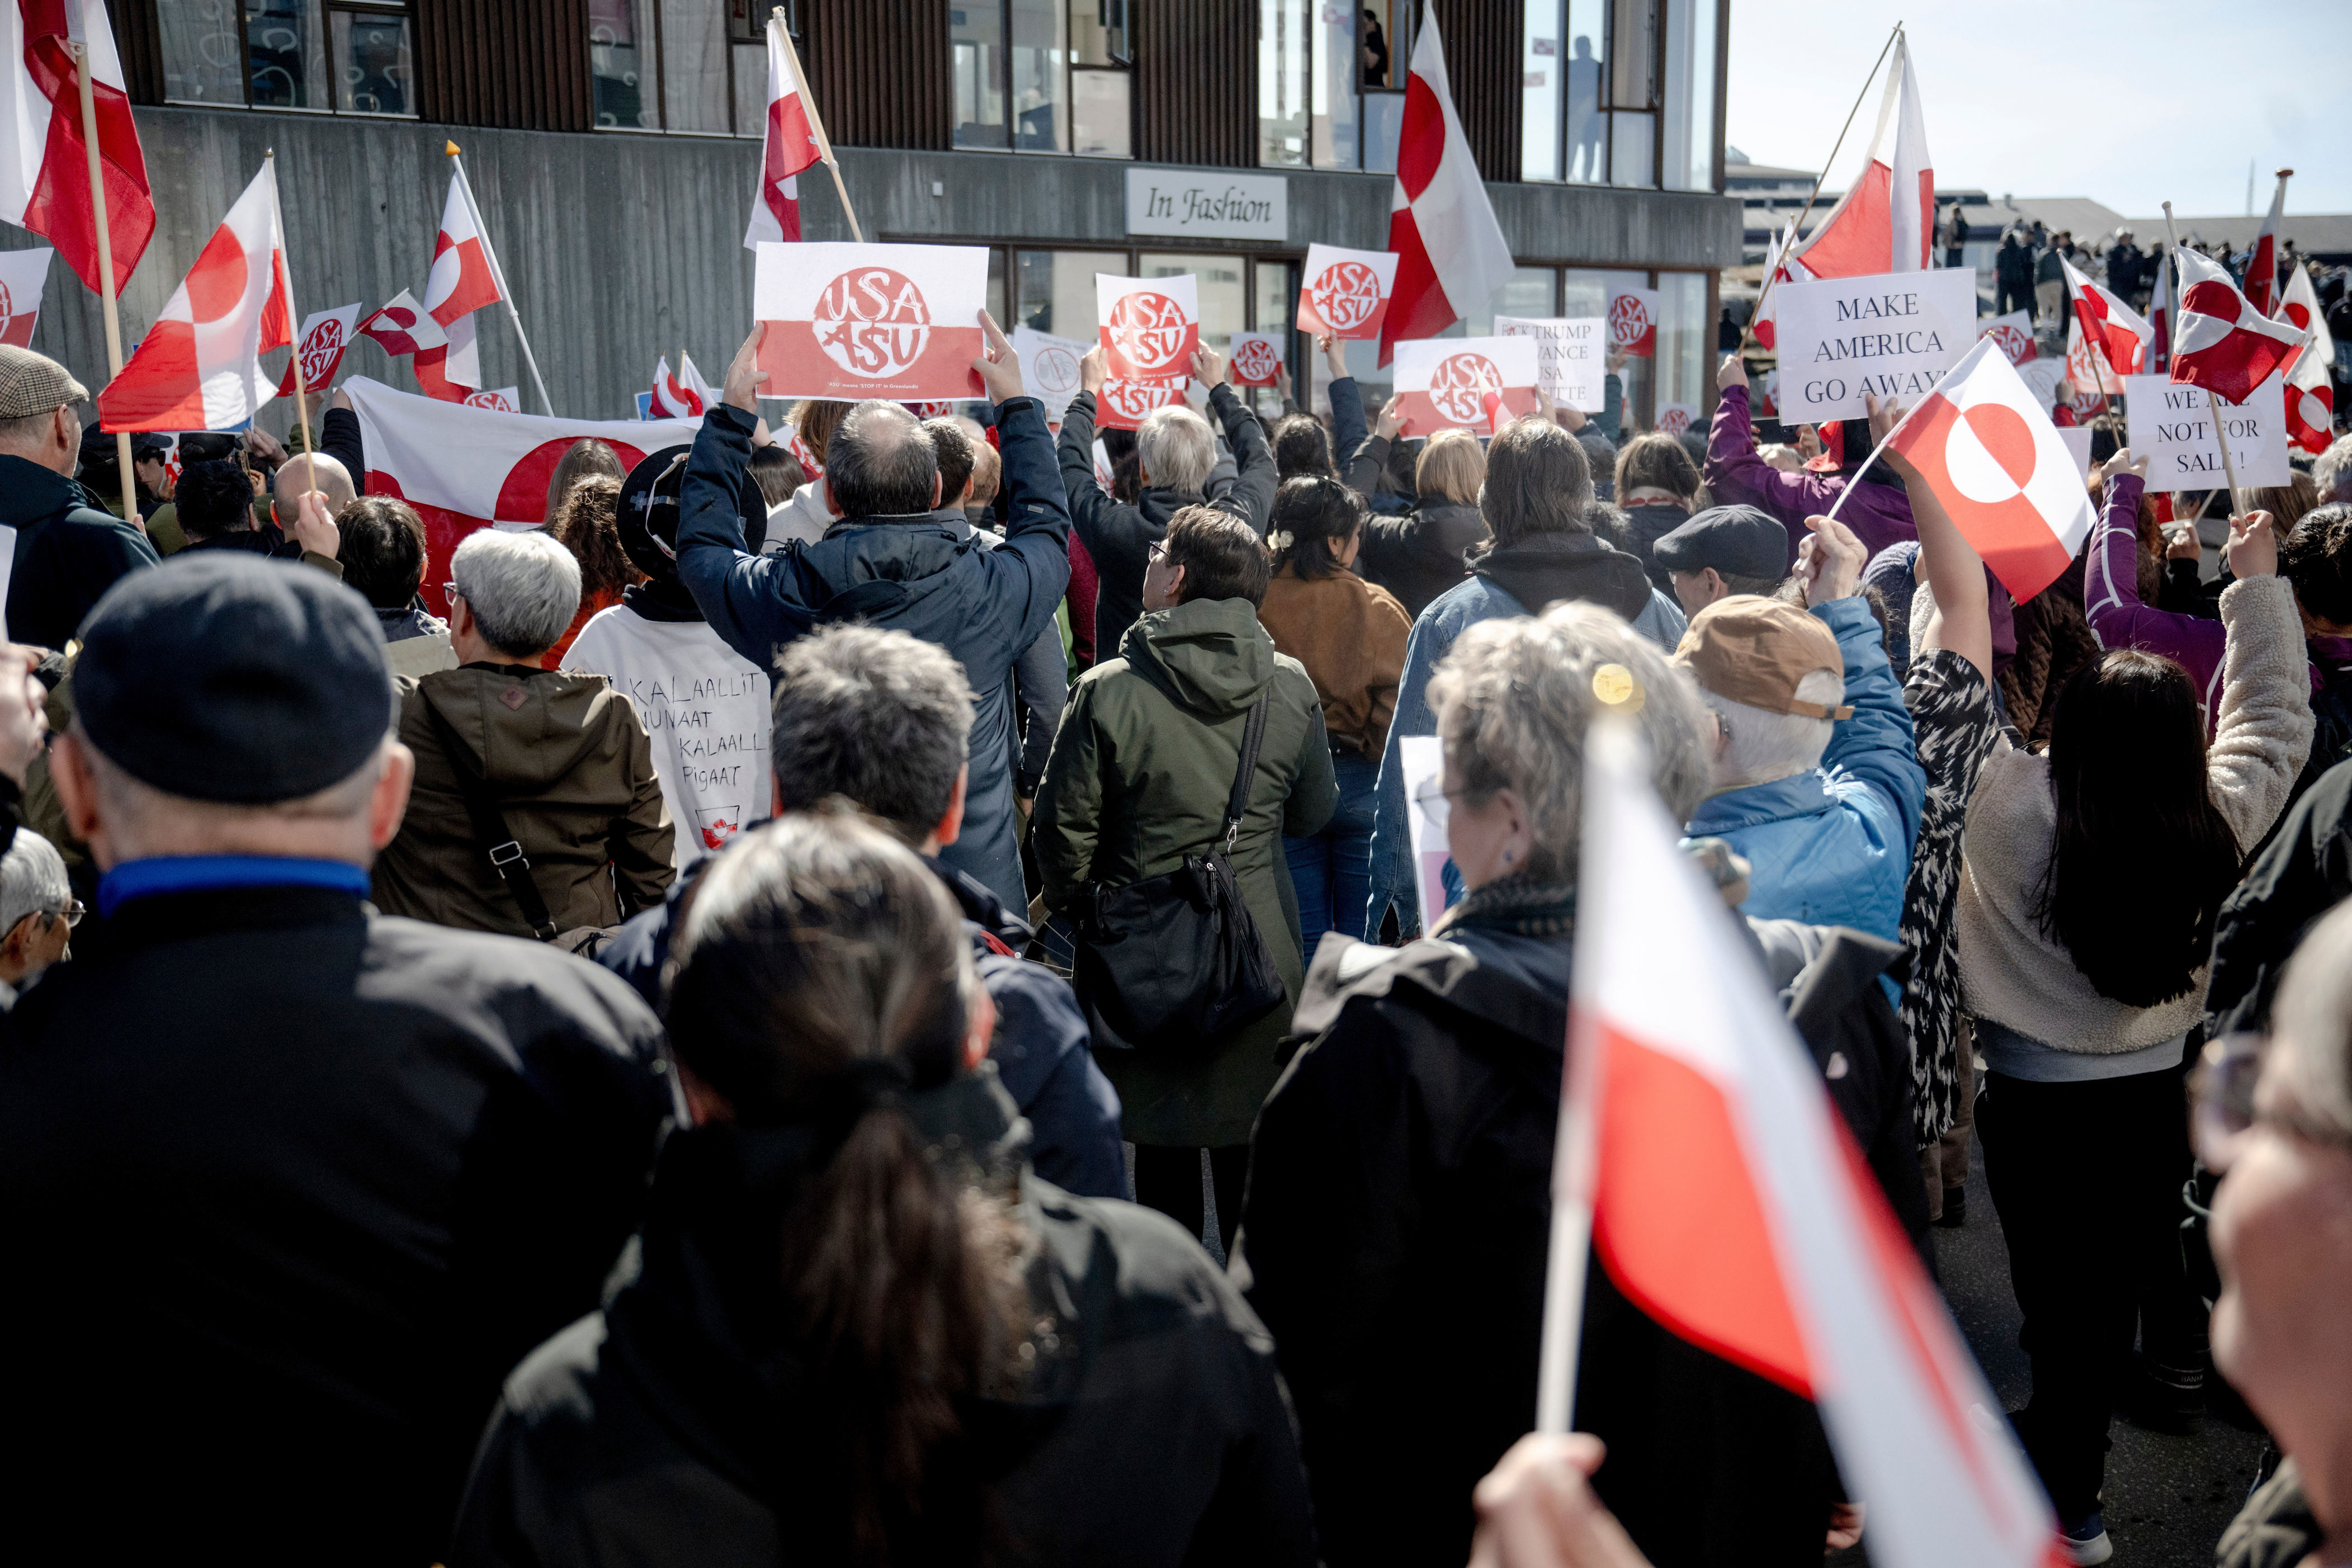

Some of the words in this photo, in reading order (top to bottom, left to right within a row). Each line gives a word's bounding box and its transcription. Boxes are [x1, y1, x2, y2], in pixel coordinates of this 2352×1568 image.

[1145, 187, 1173, 218] In
[1180, 185, 1273, 225] Fashion
[1321, 264, 1377, 297] USA
[824, 271, 925, 324] USA
[1114, 295, 1183, 329] USA
[1315, 292, 1373, 326] ASU
[1612, 296, 1645, 324] USA
[1836, 293, 1919, 322] MAKE
[304, 320, 341, 353] USA
[823, 320, 921, 374] ASU
[1114, 329, 1181, 365] ASU
[1532, 325, 1591, 340] TRUMP
[1813, 330, 1945, 362] AMERICA
[300, 349, 336, 382] ASU
[1239, 342, 1274, 361] USA
[1238, 360, 1273, 378] ASU
[1436, 355, 1498, 390] USA
[1107, 384, 1166, 416] ASU
[1804, 379, 1846, 403] GO
[2072, 393, 2099, 410] SU
[2163, 391, 2198, 410] WE
[2157, 422, 2208, 442] NOT
